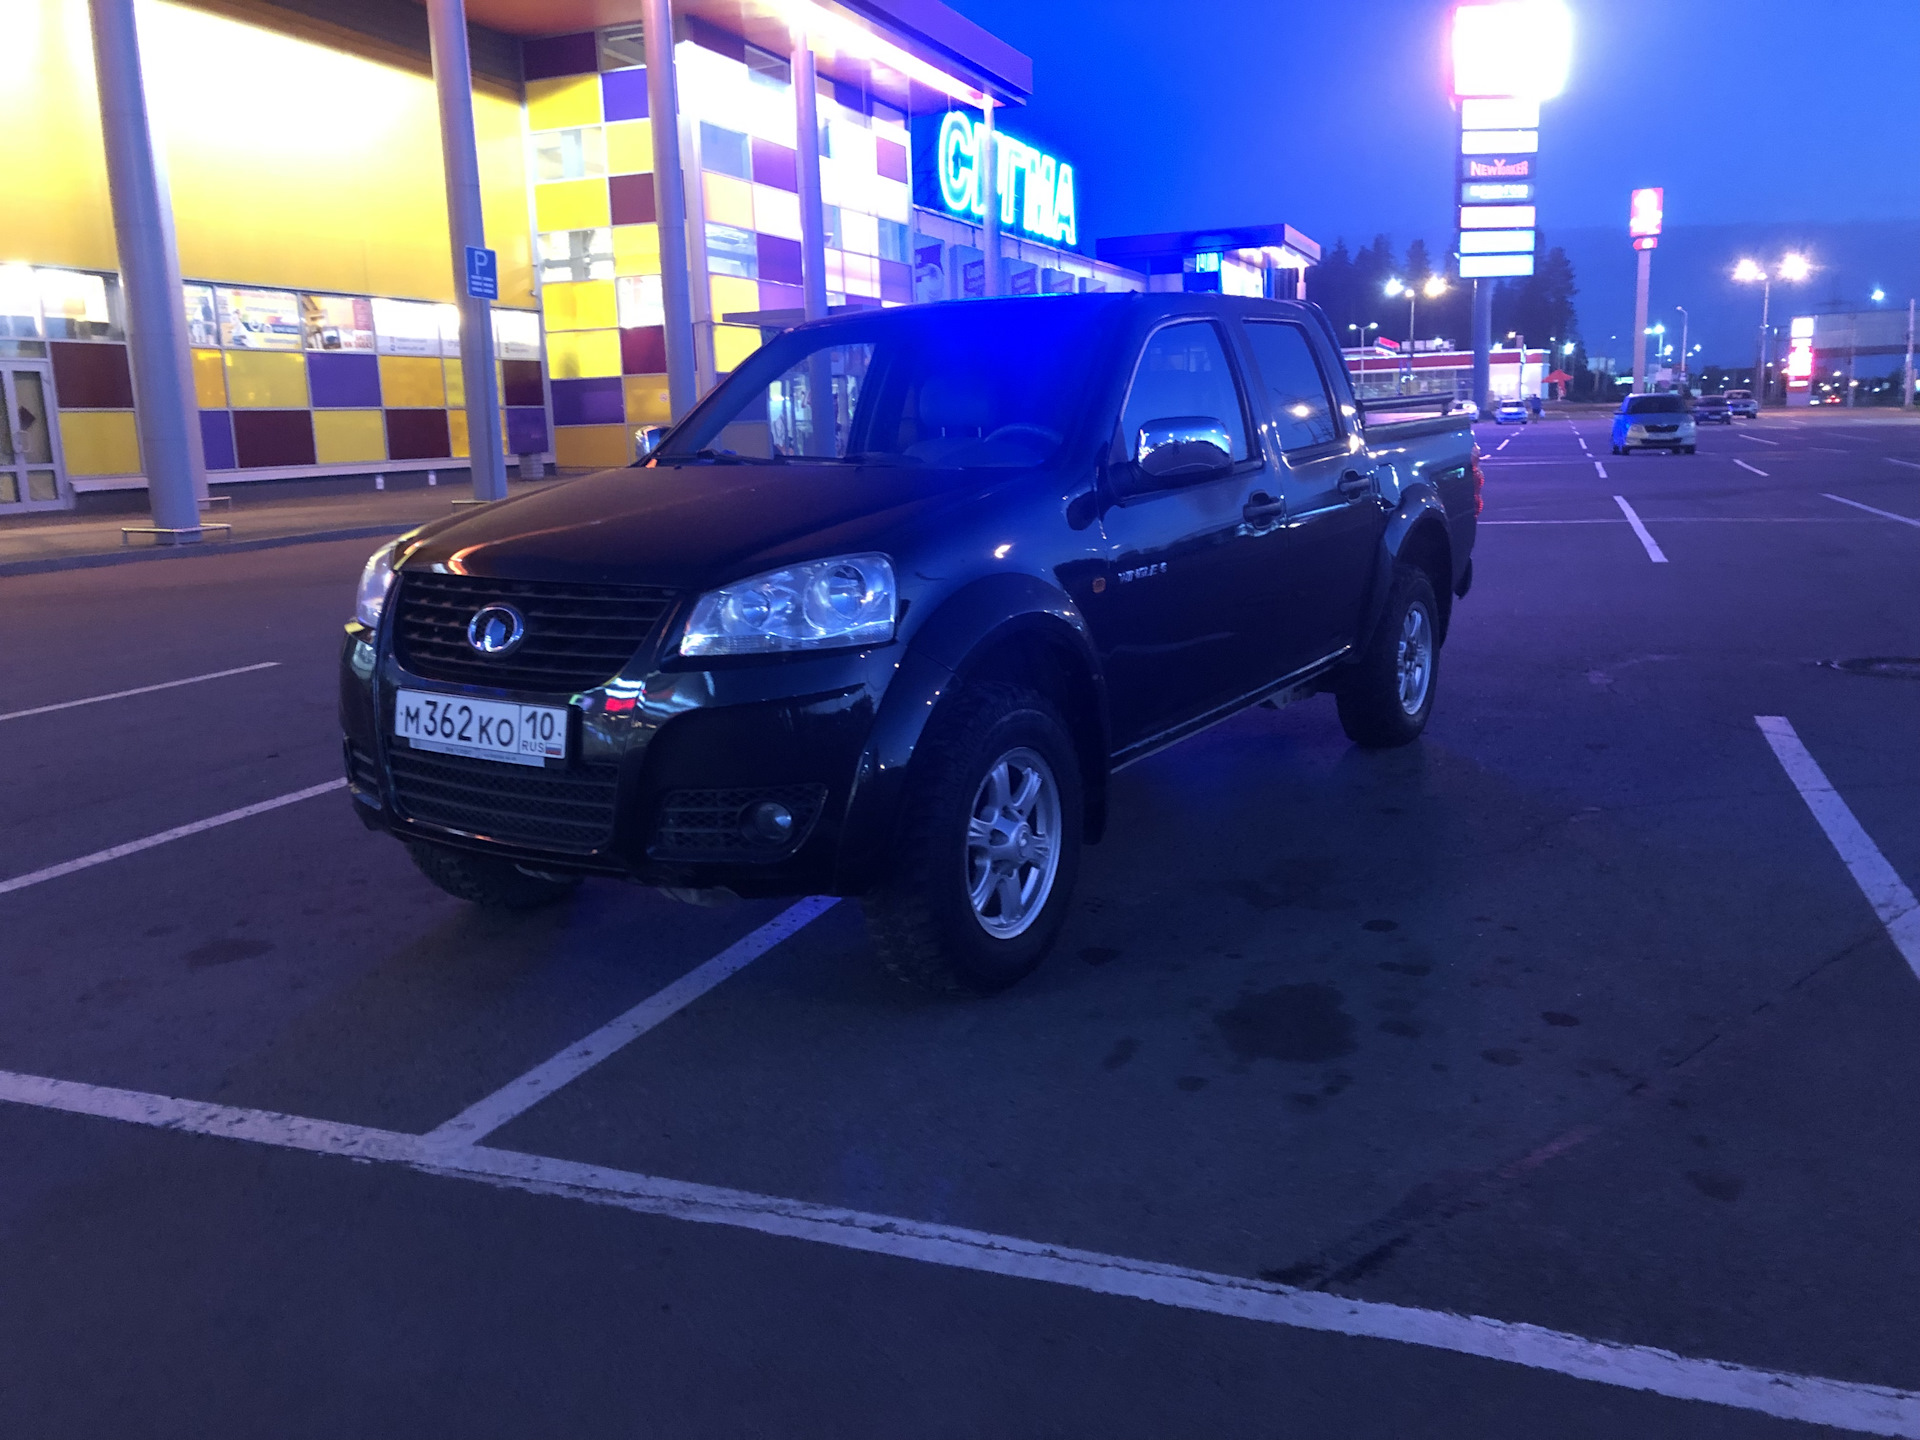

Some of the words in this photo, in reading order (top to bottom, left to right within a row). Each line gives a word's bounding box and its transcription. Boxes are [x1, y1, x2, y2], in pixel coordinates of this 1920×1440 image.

[474, 250, 489, 275] P
[525, 711, 554, 740] 10
[521, 740, 545, 754] RUS
